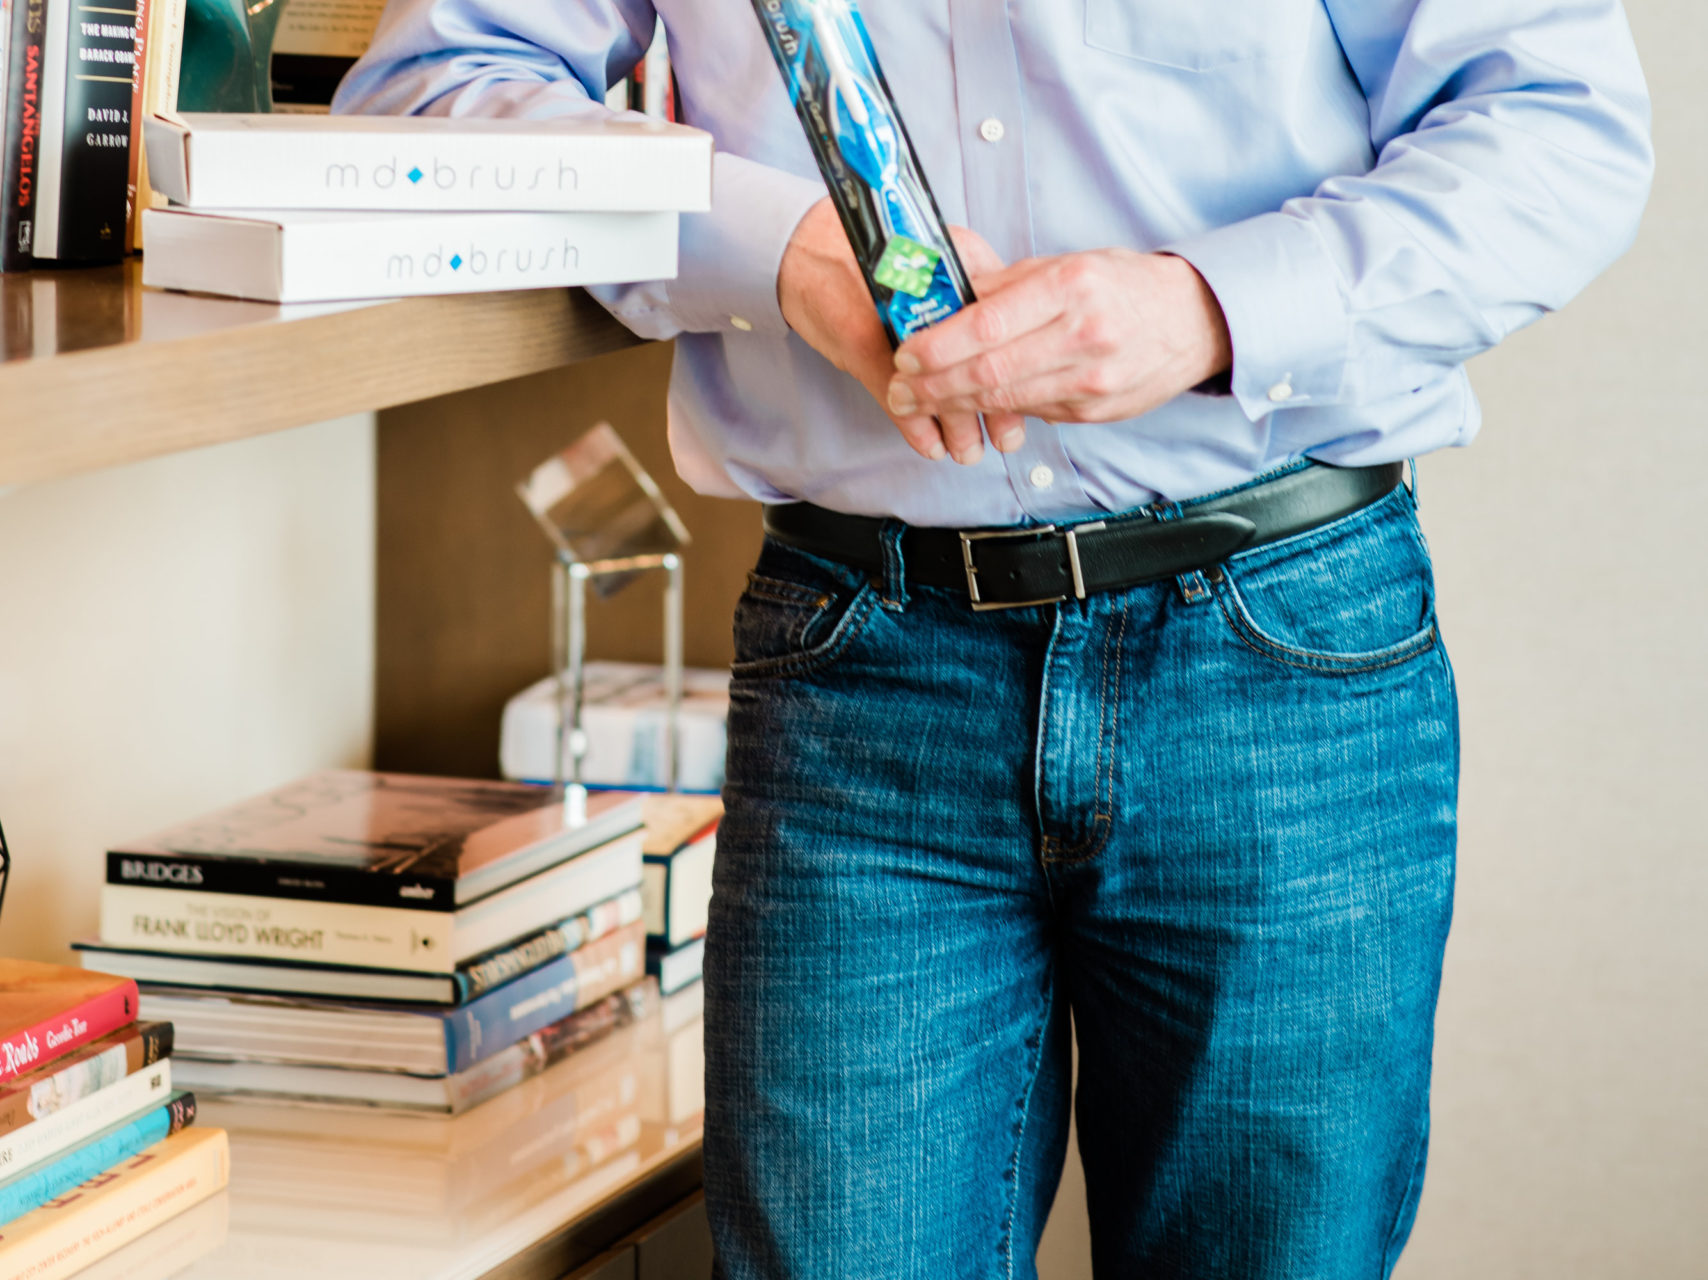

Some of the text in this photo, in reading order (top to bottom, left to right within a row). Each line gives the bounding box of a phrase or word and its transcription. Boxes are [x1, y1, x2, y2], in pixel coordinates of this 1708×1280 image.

[80, 22, 100, 36] THE
[101, 24, 130, 39] MAKING
[79, 47, 114, 62] BARACK
[87, 107, 121, 122] DAVID
[18, 44, 40, 207] SANTANGELOS
[86, 133, 129, 148] GARROW
[121, 859, 204, 884] BRIDGES
[186, 903, 209, 917] THE
[212, 905, 252, 920] VISION
[133, 915, 190, 938] FRANK
[194, 921, 249, 944] LLOYD
[253, 926, 326, 949] WRIGHT
